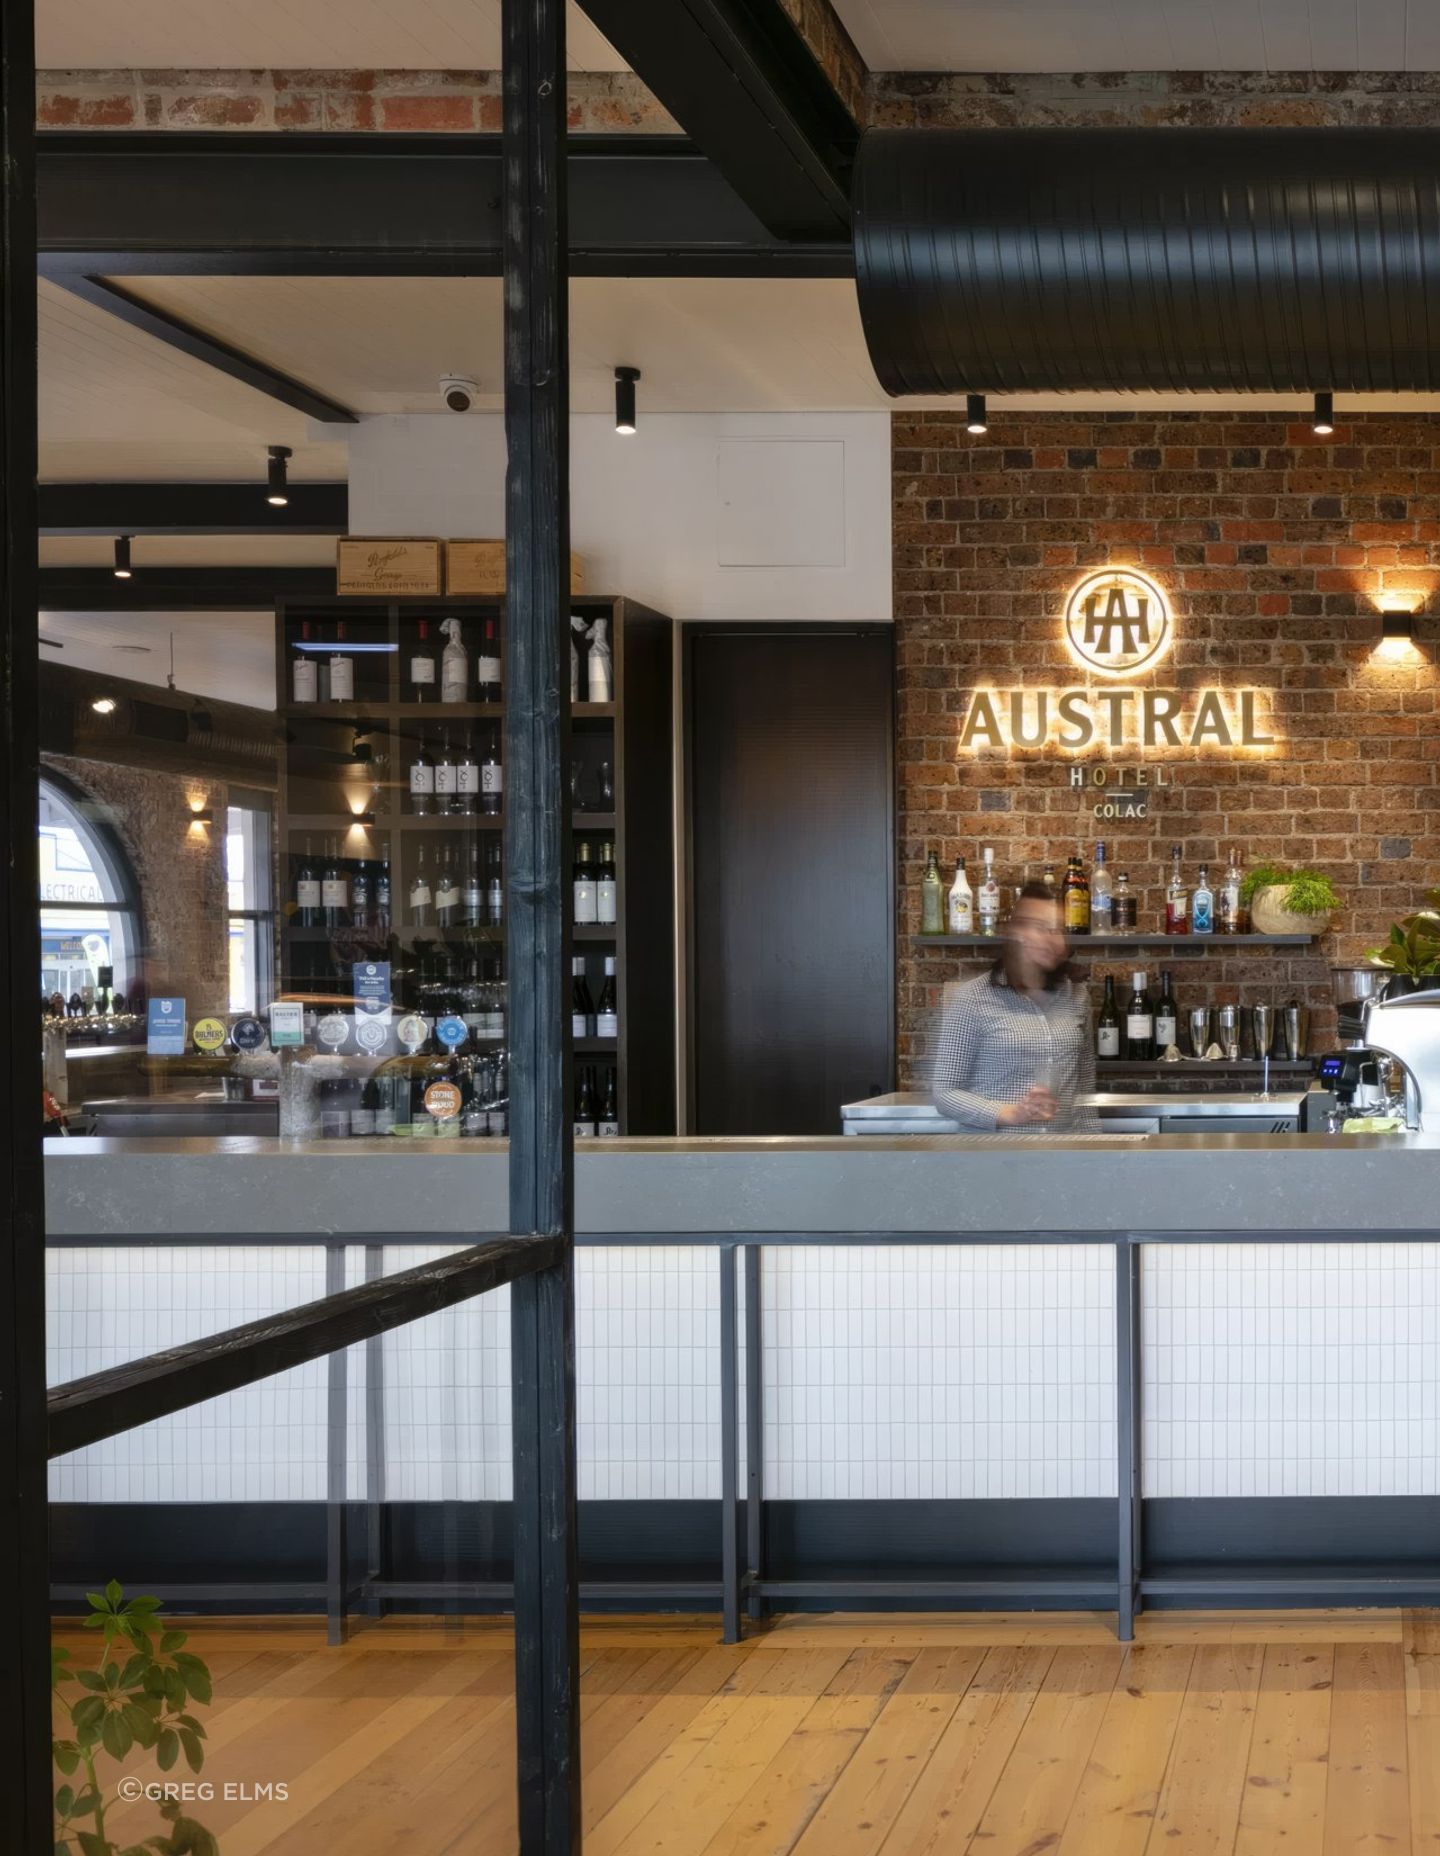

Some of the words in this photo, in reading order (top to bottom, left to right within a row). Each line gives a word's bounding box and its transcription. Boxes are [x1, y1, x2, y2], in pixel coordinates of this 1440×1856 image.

[959, 690, 1275, 748] AUSTRAL
[1070, 767, 1169, 786] HOTEL
[1093, 803, 1147, 819] COLAC
